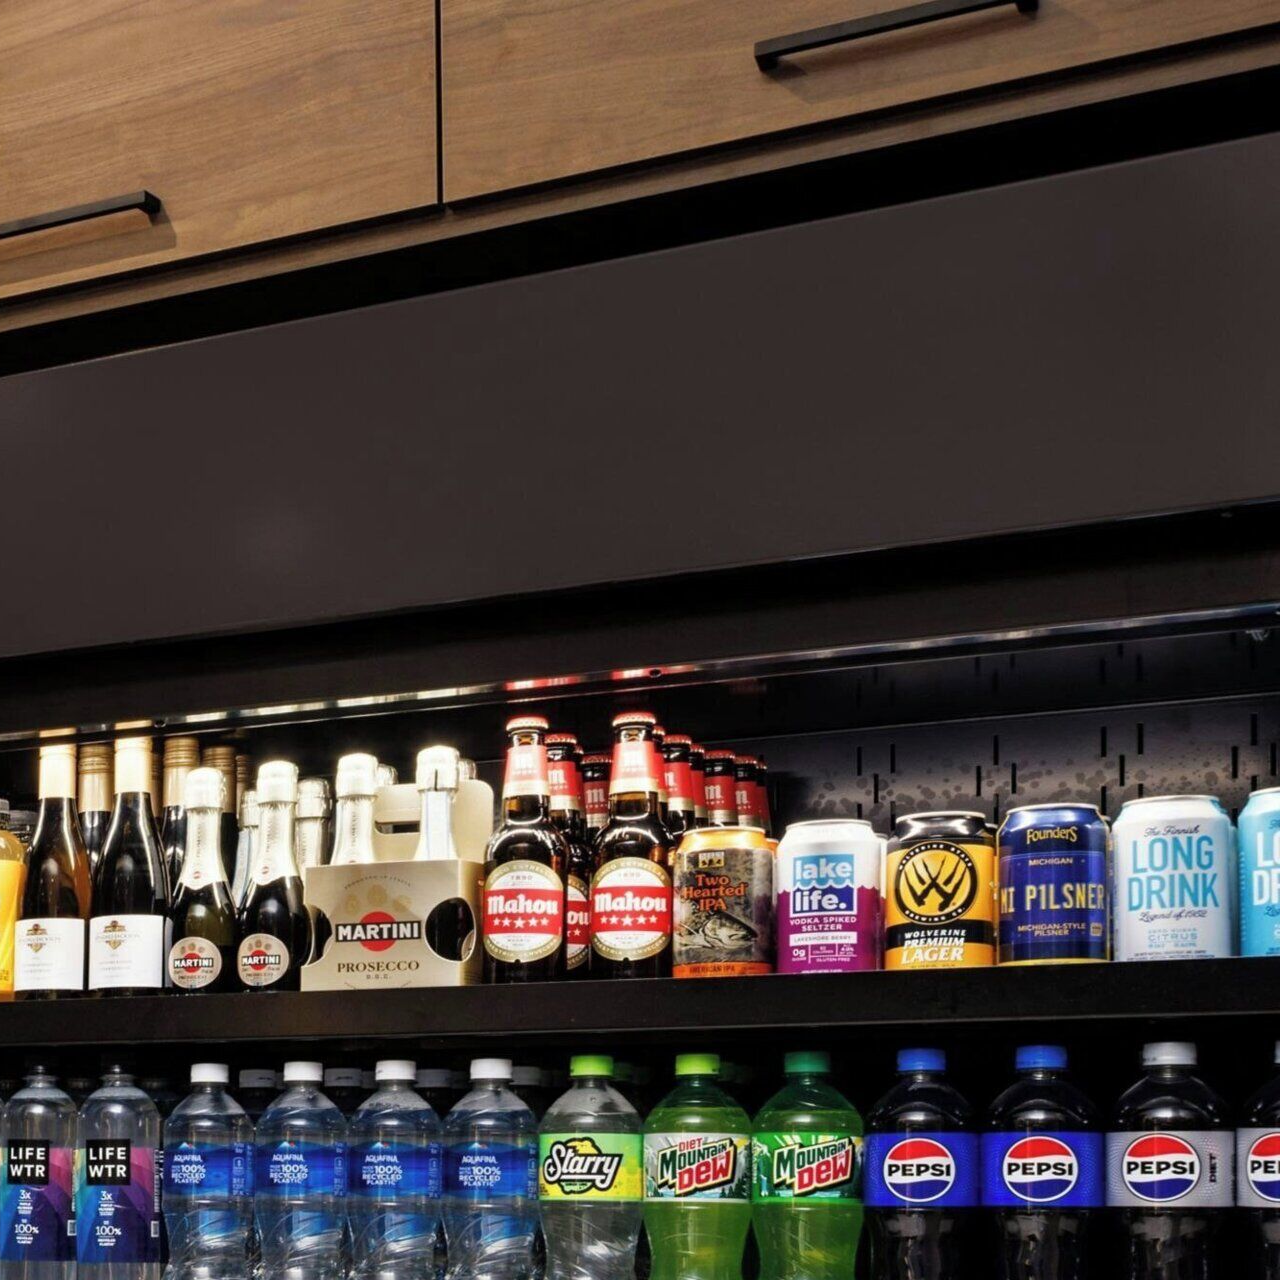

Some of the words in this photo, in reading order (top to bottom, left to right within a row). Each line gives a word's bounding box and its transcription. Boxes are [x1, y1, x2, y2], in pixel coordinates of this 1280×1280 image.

[1162, 825, 1201, 837] Finnish
[1132, 835, 1214, 874] LONG
[1028, 857, 1074, 867] MICHIGAN
[795, 858, 852, 880] lake
[695, 873, 729, 886] Two
[682, 884, 746, 899] Hearted
[1128, 873, 1219, 912] DRINK
[488, 893, 559, 915] Mahou
[594, 891, 667, 913] Mahou
[699, 898, 727, 911] IPA
[795, 891, 847, 912] life.
[1000, 886, 1016, 914] MI
[790, 917, 819, 926] VODKA
[823, 916, 857, 924] SPIKED
[905, 909, 946, 922] BREWING
[1139, 911, 1173, 923] Legend
[338, 922, 420, 941] MARTINI
[801, 924, 843, 932] SELTZER
[1017, 922, 1086, 932] MICHIGAN-STYLE
[1034, 928, 1069, 937] PILSNER
[794, 935, 829, 943] LAKESHORE
[904, 929, 966, 939] WOLVERINE
[1148, 933, 1198, 942] CITRUS
[903, 937, 965, 949] PREMIUM
[792, 948, 806, 957] 0g
[901, 947, 964, 965] LAGER
[174, 958, 213, 967] MARTINI
[242, 956, 281, 965] MARTINI
[337, 960, 420, 974] PROSECCO
[679, 1137, 703, 1150] DIET
[10, 1148, 46, 1160] LIFE
[89, 1148, 127, 1160] LIFE
[173, 1154, 203, 1163] AQUAFINA
[272, 1154, 305, 1163] AQUAFINA
[365, 1154, 399, 1163] AQUAFINA
[10, 1164, 46, 1177] WTR
[89, 1164, 127, 1178] WTR
[544, 1141, 618, 1190] Starry
[888, 1162, 951, 1177] PEPSI
[1007, 1162, 1074, 1177] PEPSI
[1126, 1160, 1195, 1175] PEPSI
[1209, 1153, 1218, 1183] DIET
